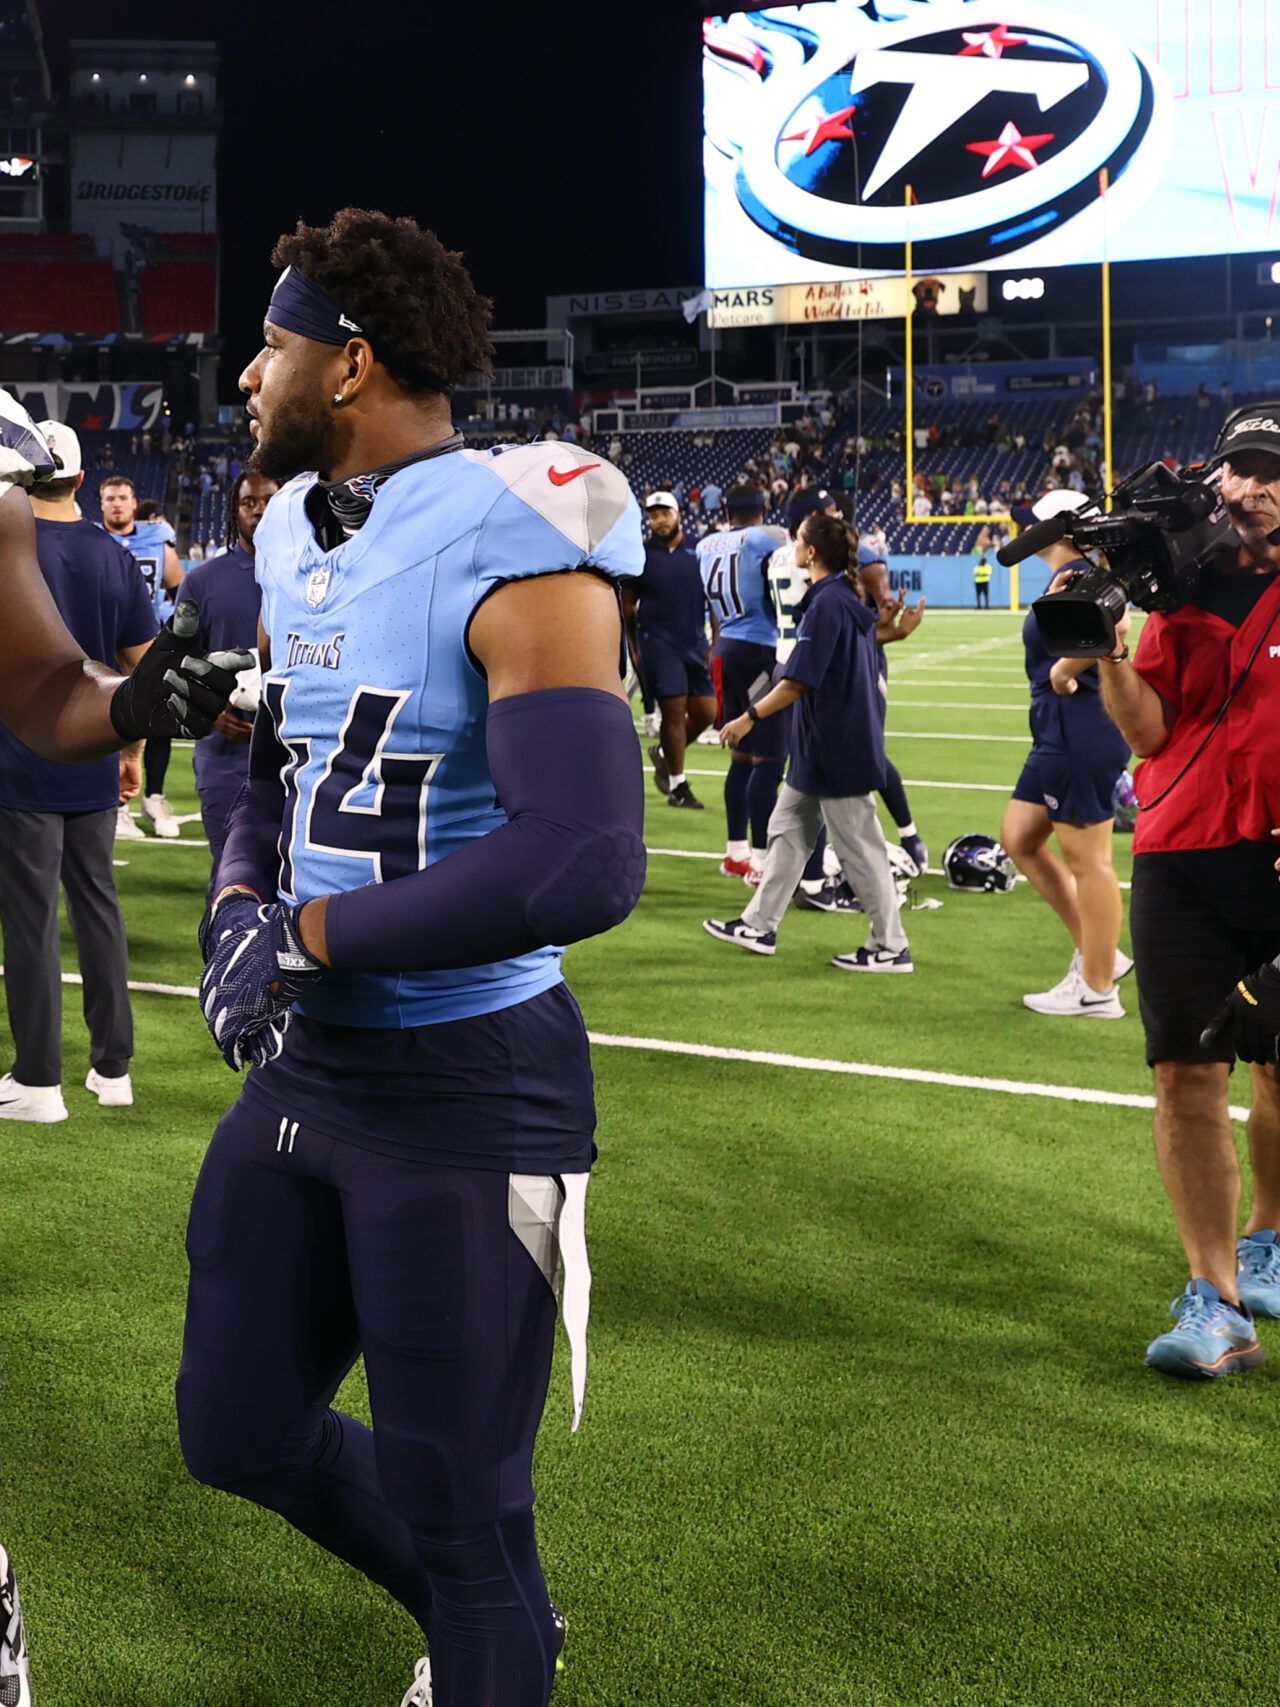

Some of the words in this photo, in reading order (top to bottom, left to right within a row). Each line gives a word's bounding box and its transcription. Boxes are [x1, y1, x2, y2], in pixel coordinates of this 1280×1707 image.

[76, 181, 212, 202] BRIDGESTONE
[714, 289, 774, 309] MARS
[705, 552, 746, 619] 41
[287, 632, 345, 670] TITANS
